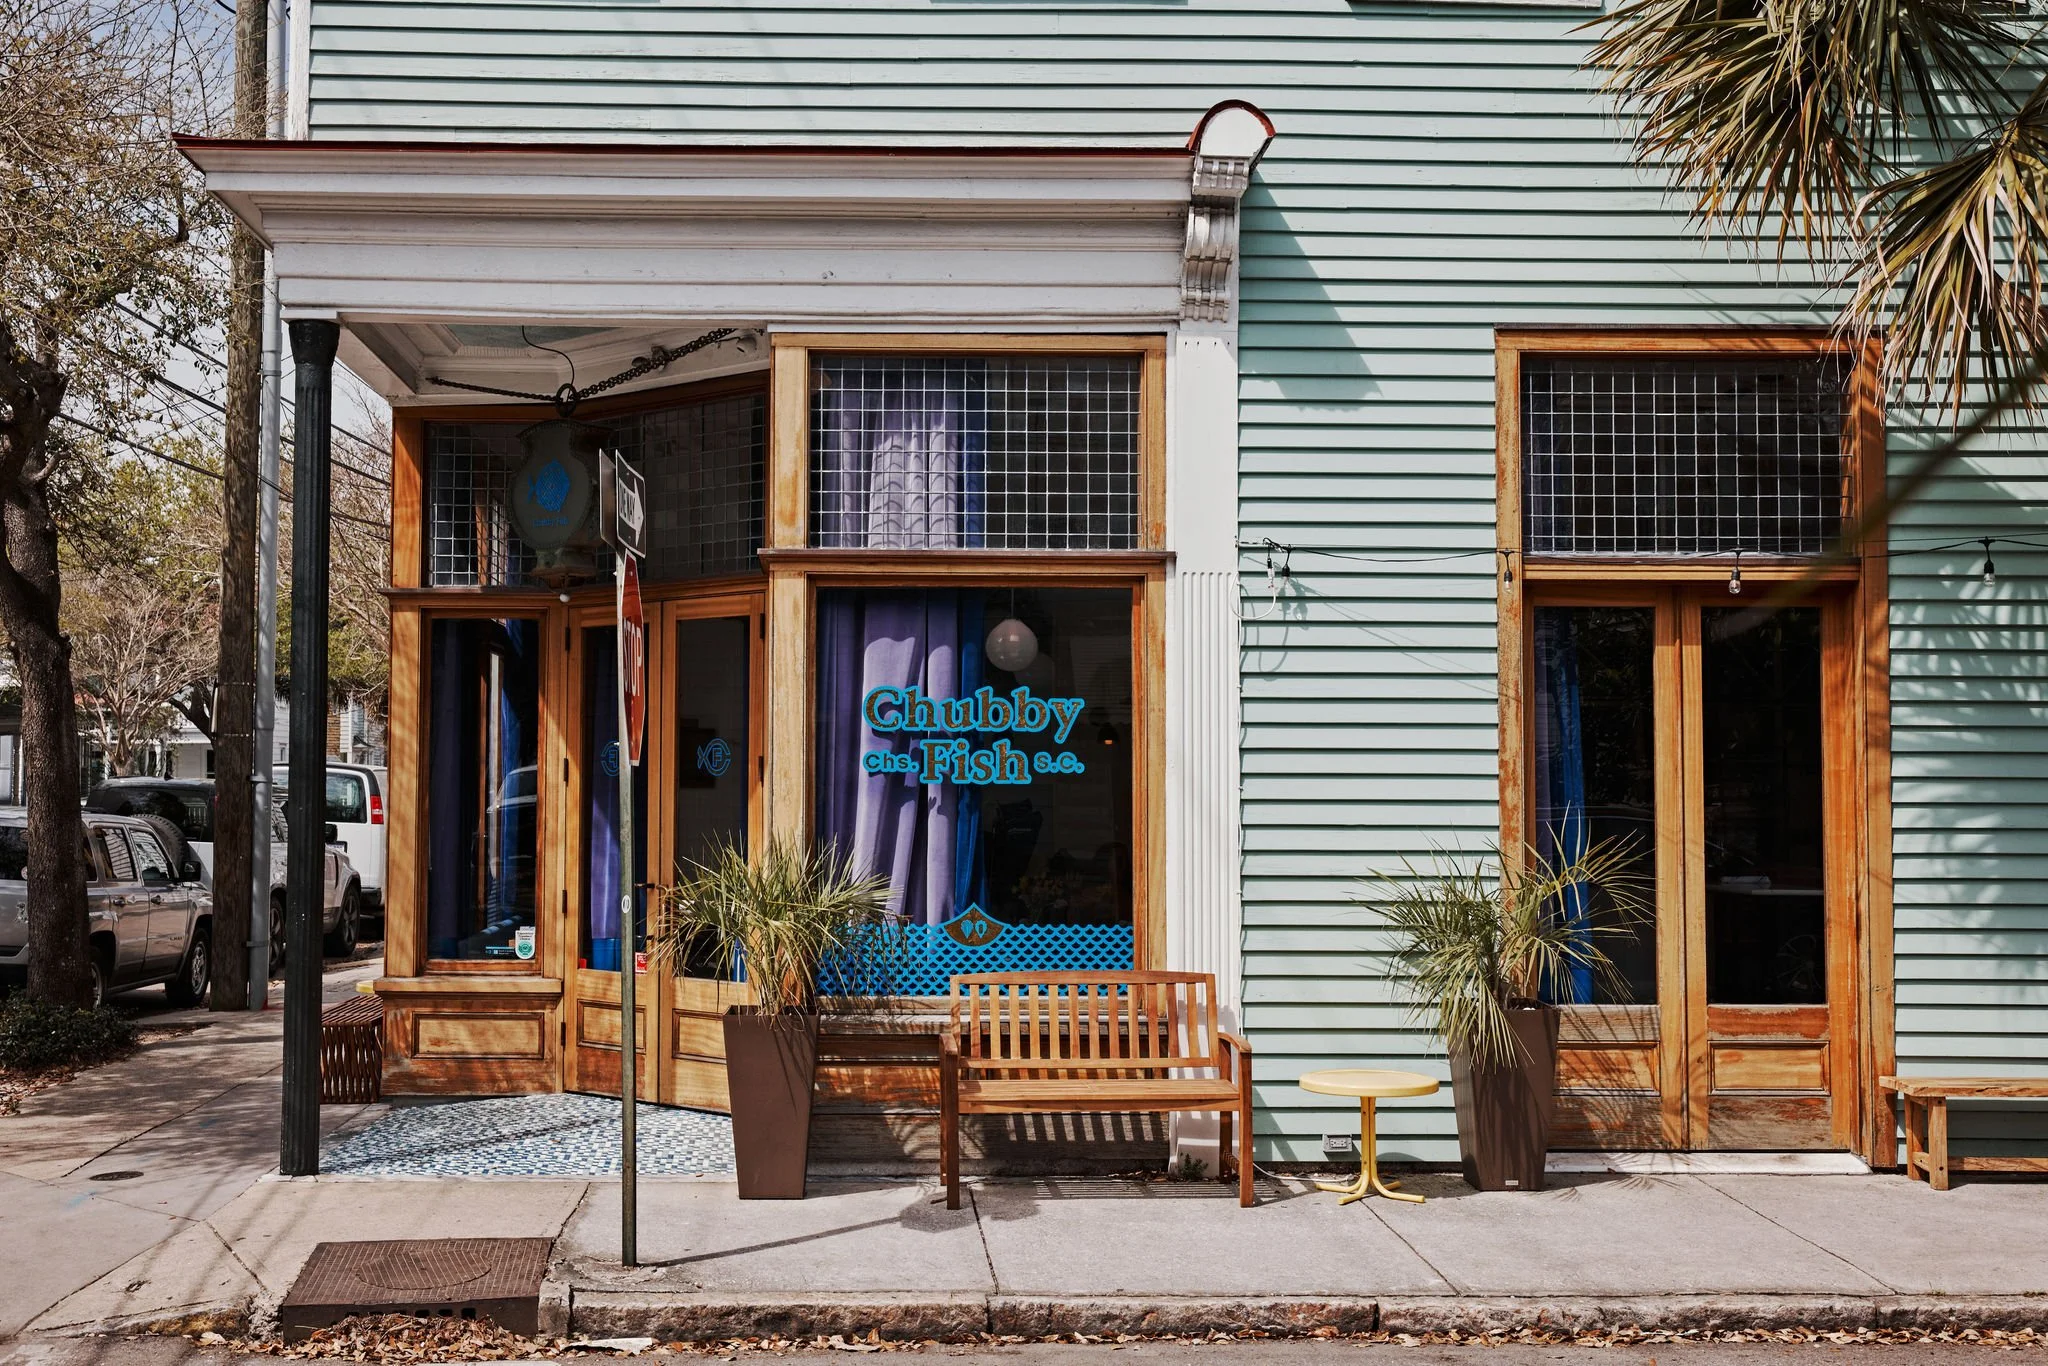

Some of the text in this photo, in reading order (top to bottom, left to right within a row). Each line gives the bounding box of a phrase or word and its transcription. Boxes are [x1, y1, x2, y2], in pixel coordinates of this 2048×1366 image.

[623, 617, 643, 697] STOP
[863, 686, 1085, 744] Chubby
[863, 750, 919, 772] Chs.
[920, 738, 1032, 785] Fish
